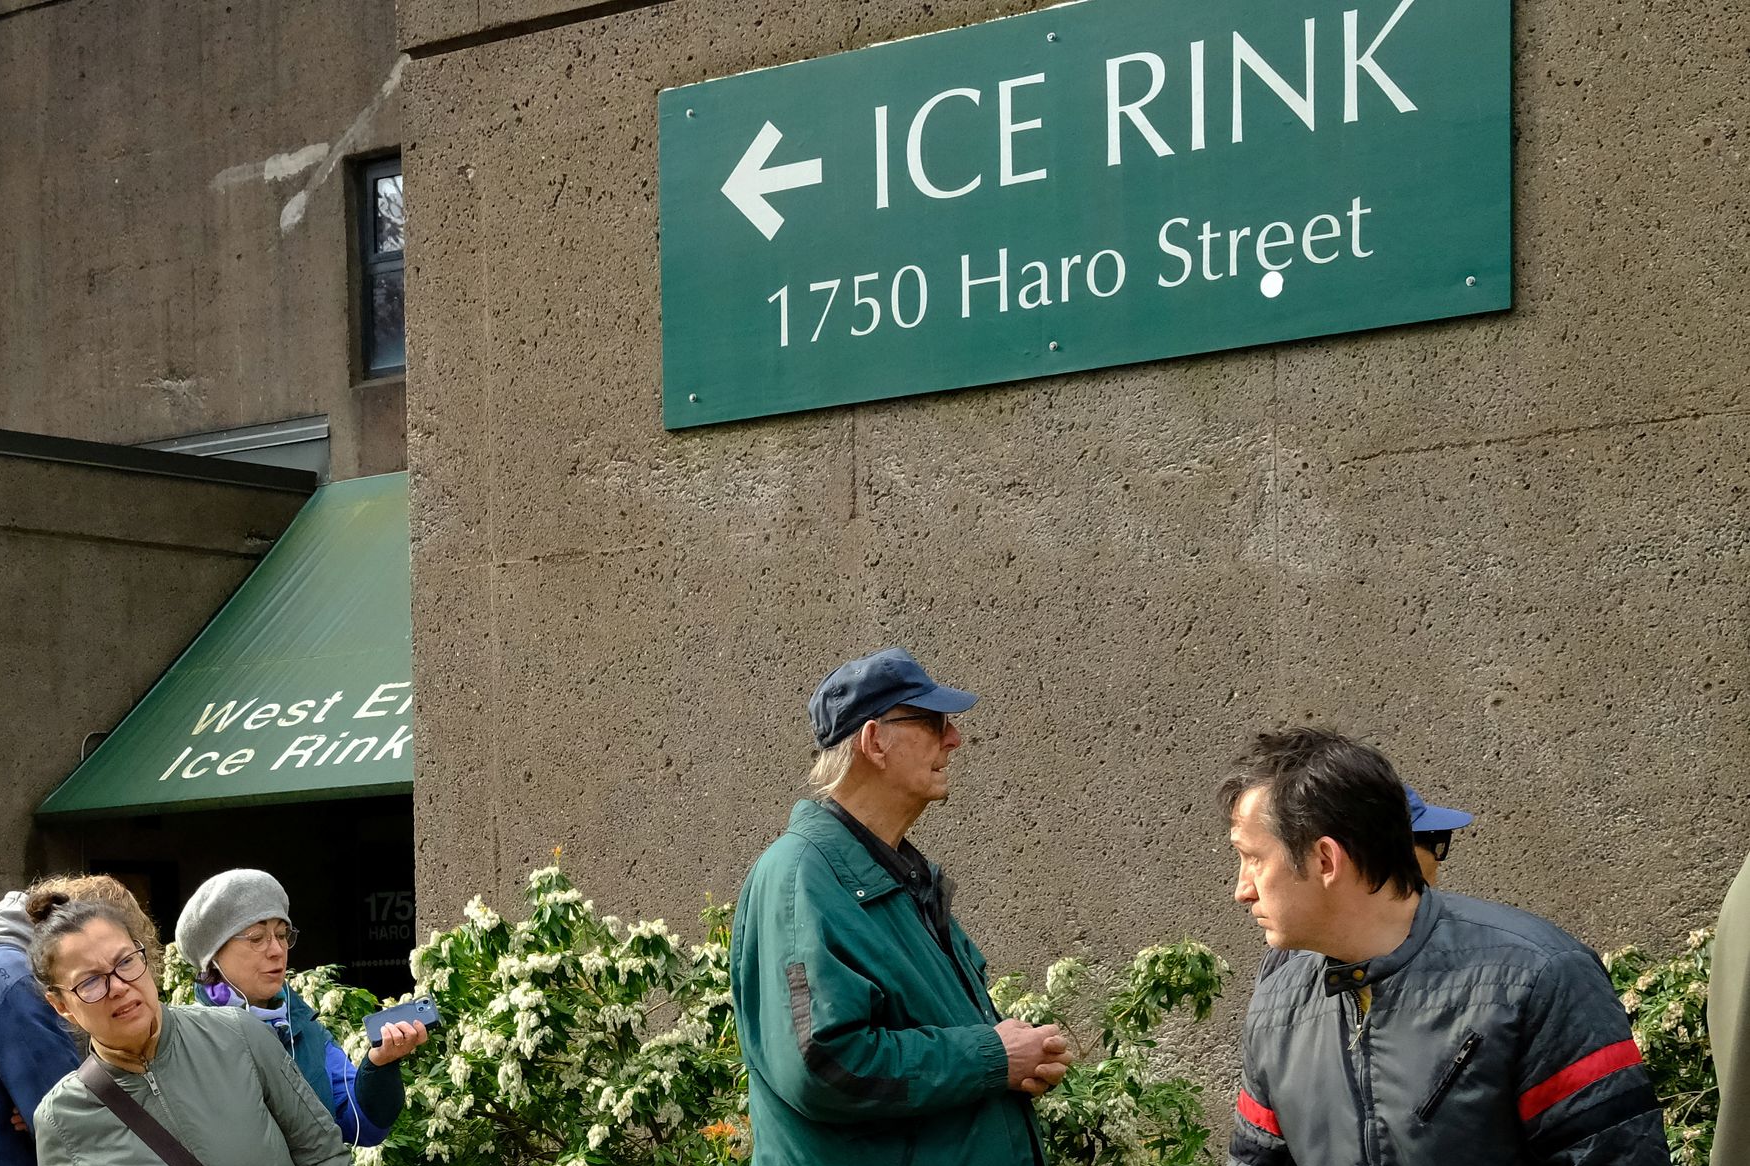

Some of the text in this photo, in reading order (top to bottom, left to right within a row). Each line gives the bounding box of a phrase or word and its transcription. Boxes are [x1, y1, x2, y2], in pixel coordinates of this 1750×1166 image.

[874, 0, 1419, 210] ICE RINK
[767, 196, 1374, 348] 1750 Haro Street
[191, 681, 413, 736] West E
[158, 725, 413, 781] Ice Rink
[369, 924, 410, 941] HARO
